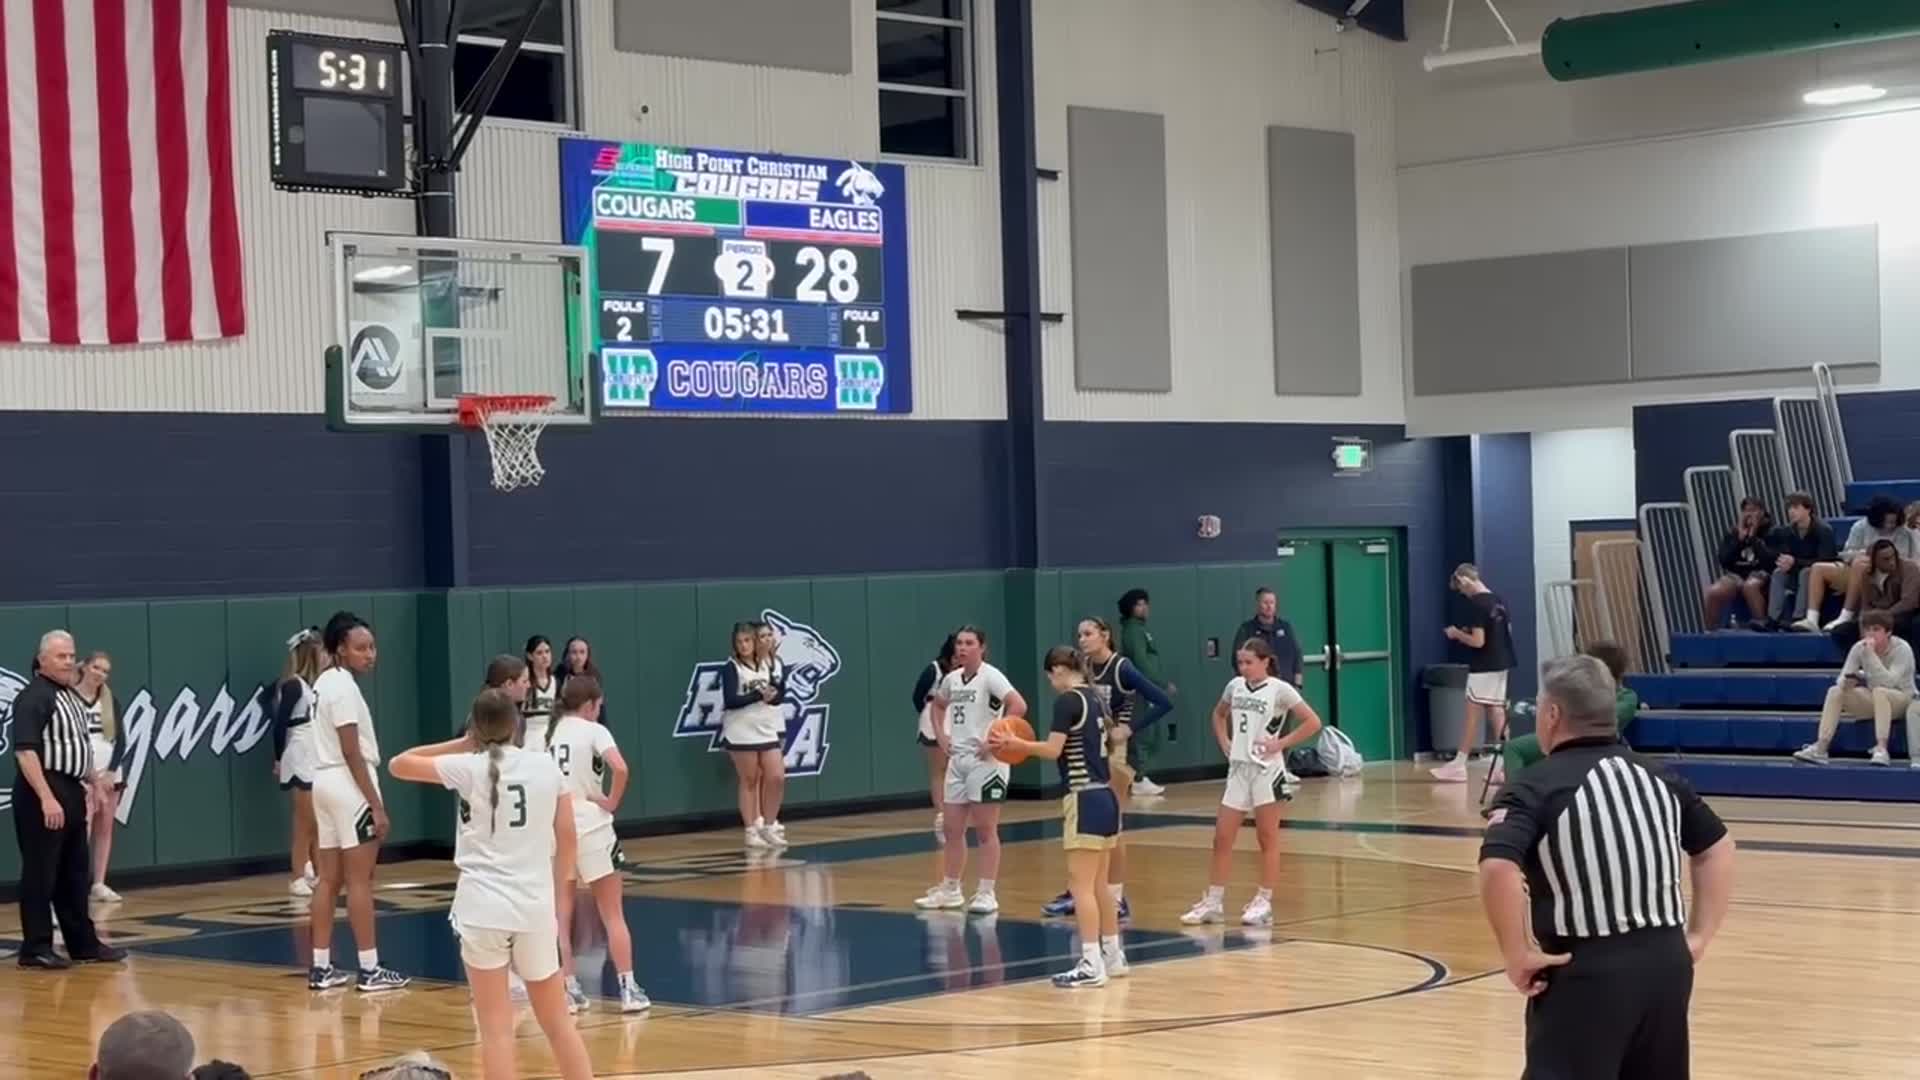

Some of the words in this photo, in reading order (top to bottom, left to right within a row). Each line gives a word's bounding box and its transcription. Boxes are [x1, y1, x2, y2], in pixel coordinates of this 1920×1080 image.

[317, 50, 387, 90] 5:31
[655, 148, 694, 170] HIGH
[696, 152, 745, 174] POINT
[747, 156, 828, 182] CHRISTIAN
[665, 170, 820, 204] COUGARS
[597, 193, 696, 221] COUGARS
[810, 208, 880, 232] EAGLES
[641, 237, 675, 296] 7
[736, 259, 754, 292] 2
[795, 246, 860, 304] 28
[603, 299, 645, 314] FOULS
[843, 309, 880, 323] FOULS
[616, 317, 633, 342] 2
[703, 306, 790, 342] 05:31
[855, 324, 870, 349] 1
[667, 358, 829, 400] COUGARS
[953, 705, 965, 725] 25
[1239, 713, 1248, 734] 2
[115, 680, 273, 825] gars
[507, 784, 527, 827] 3
